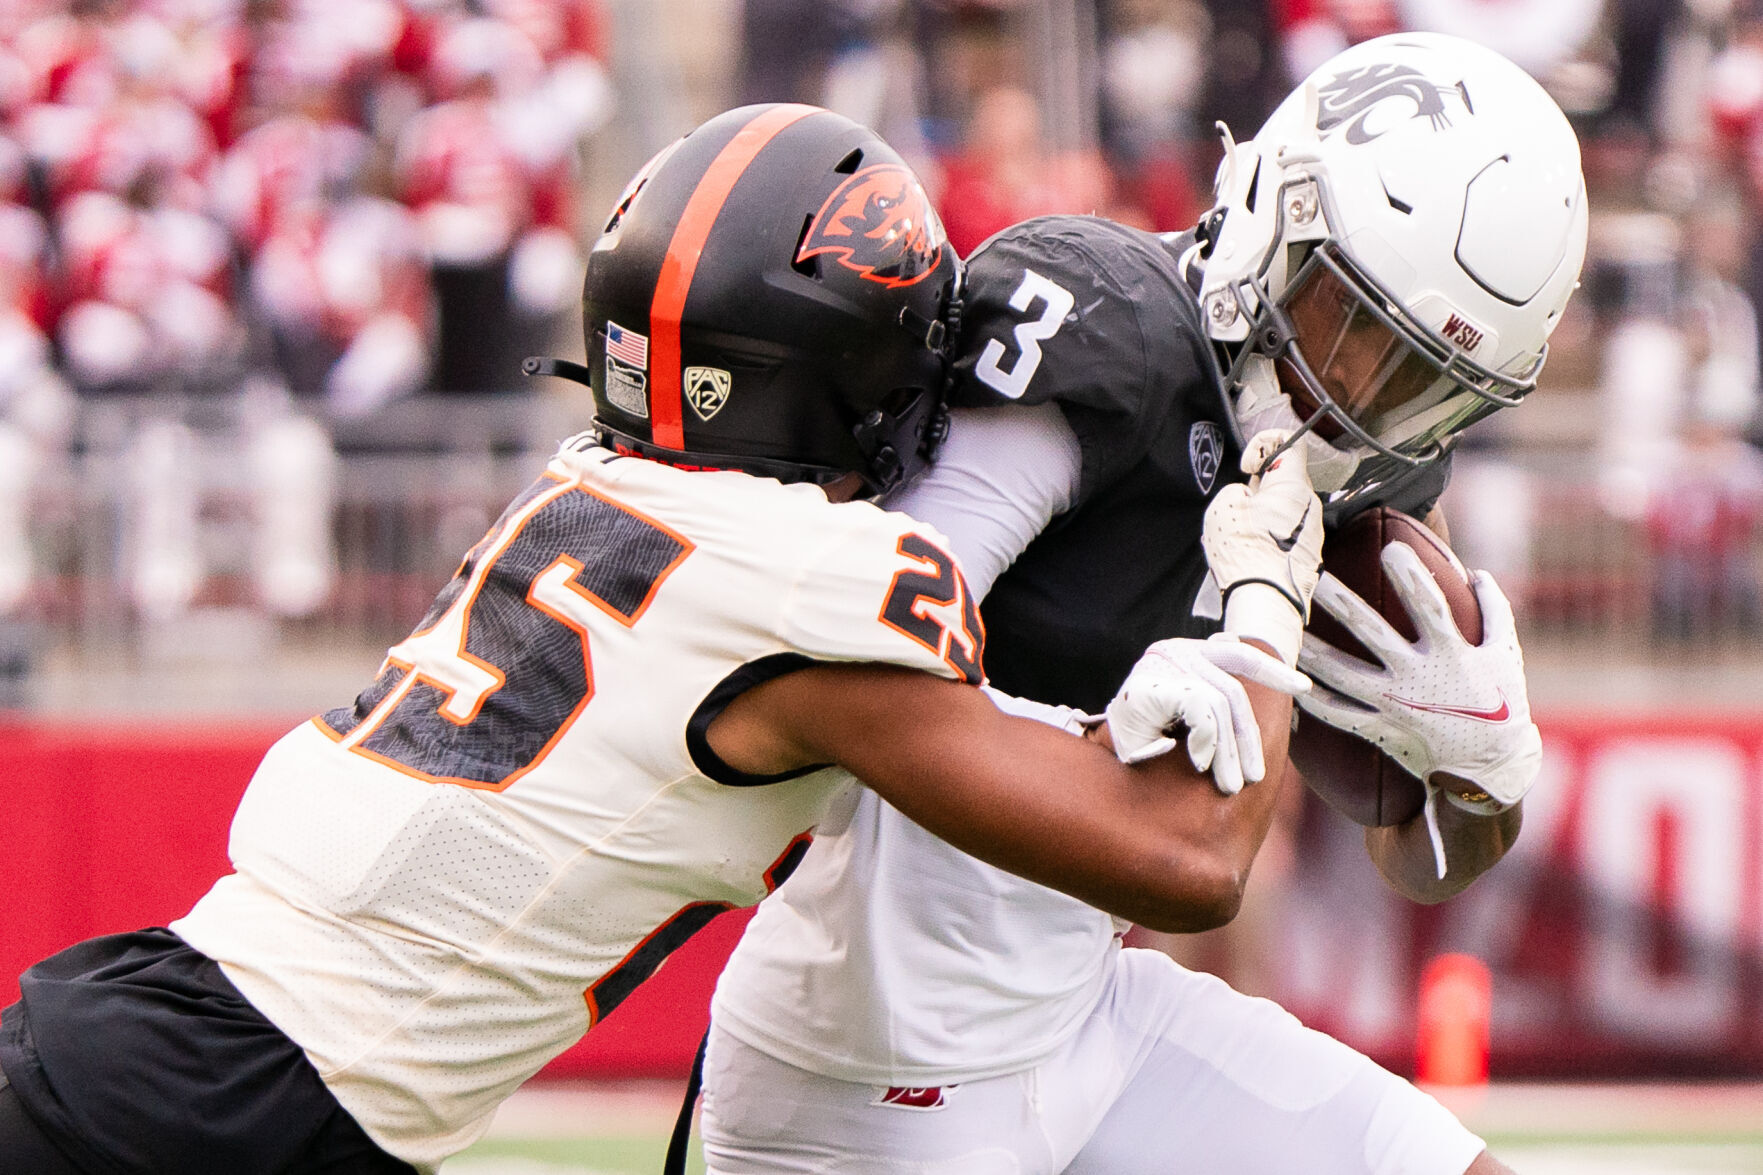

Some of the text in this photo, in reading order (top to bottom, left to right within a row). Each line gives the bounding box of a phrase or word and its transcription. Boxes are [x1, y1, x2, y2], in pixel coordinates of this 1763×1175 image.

[975, 268, 1075, 399] 3
[1442, 313, 1484, 352] WSU
[689, 369, 728, 400] PAC
[695, 390, 717, 410] 12
[1197, 451, 1213, 478] 12
[312, 470, 697, 793] 5
